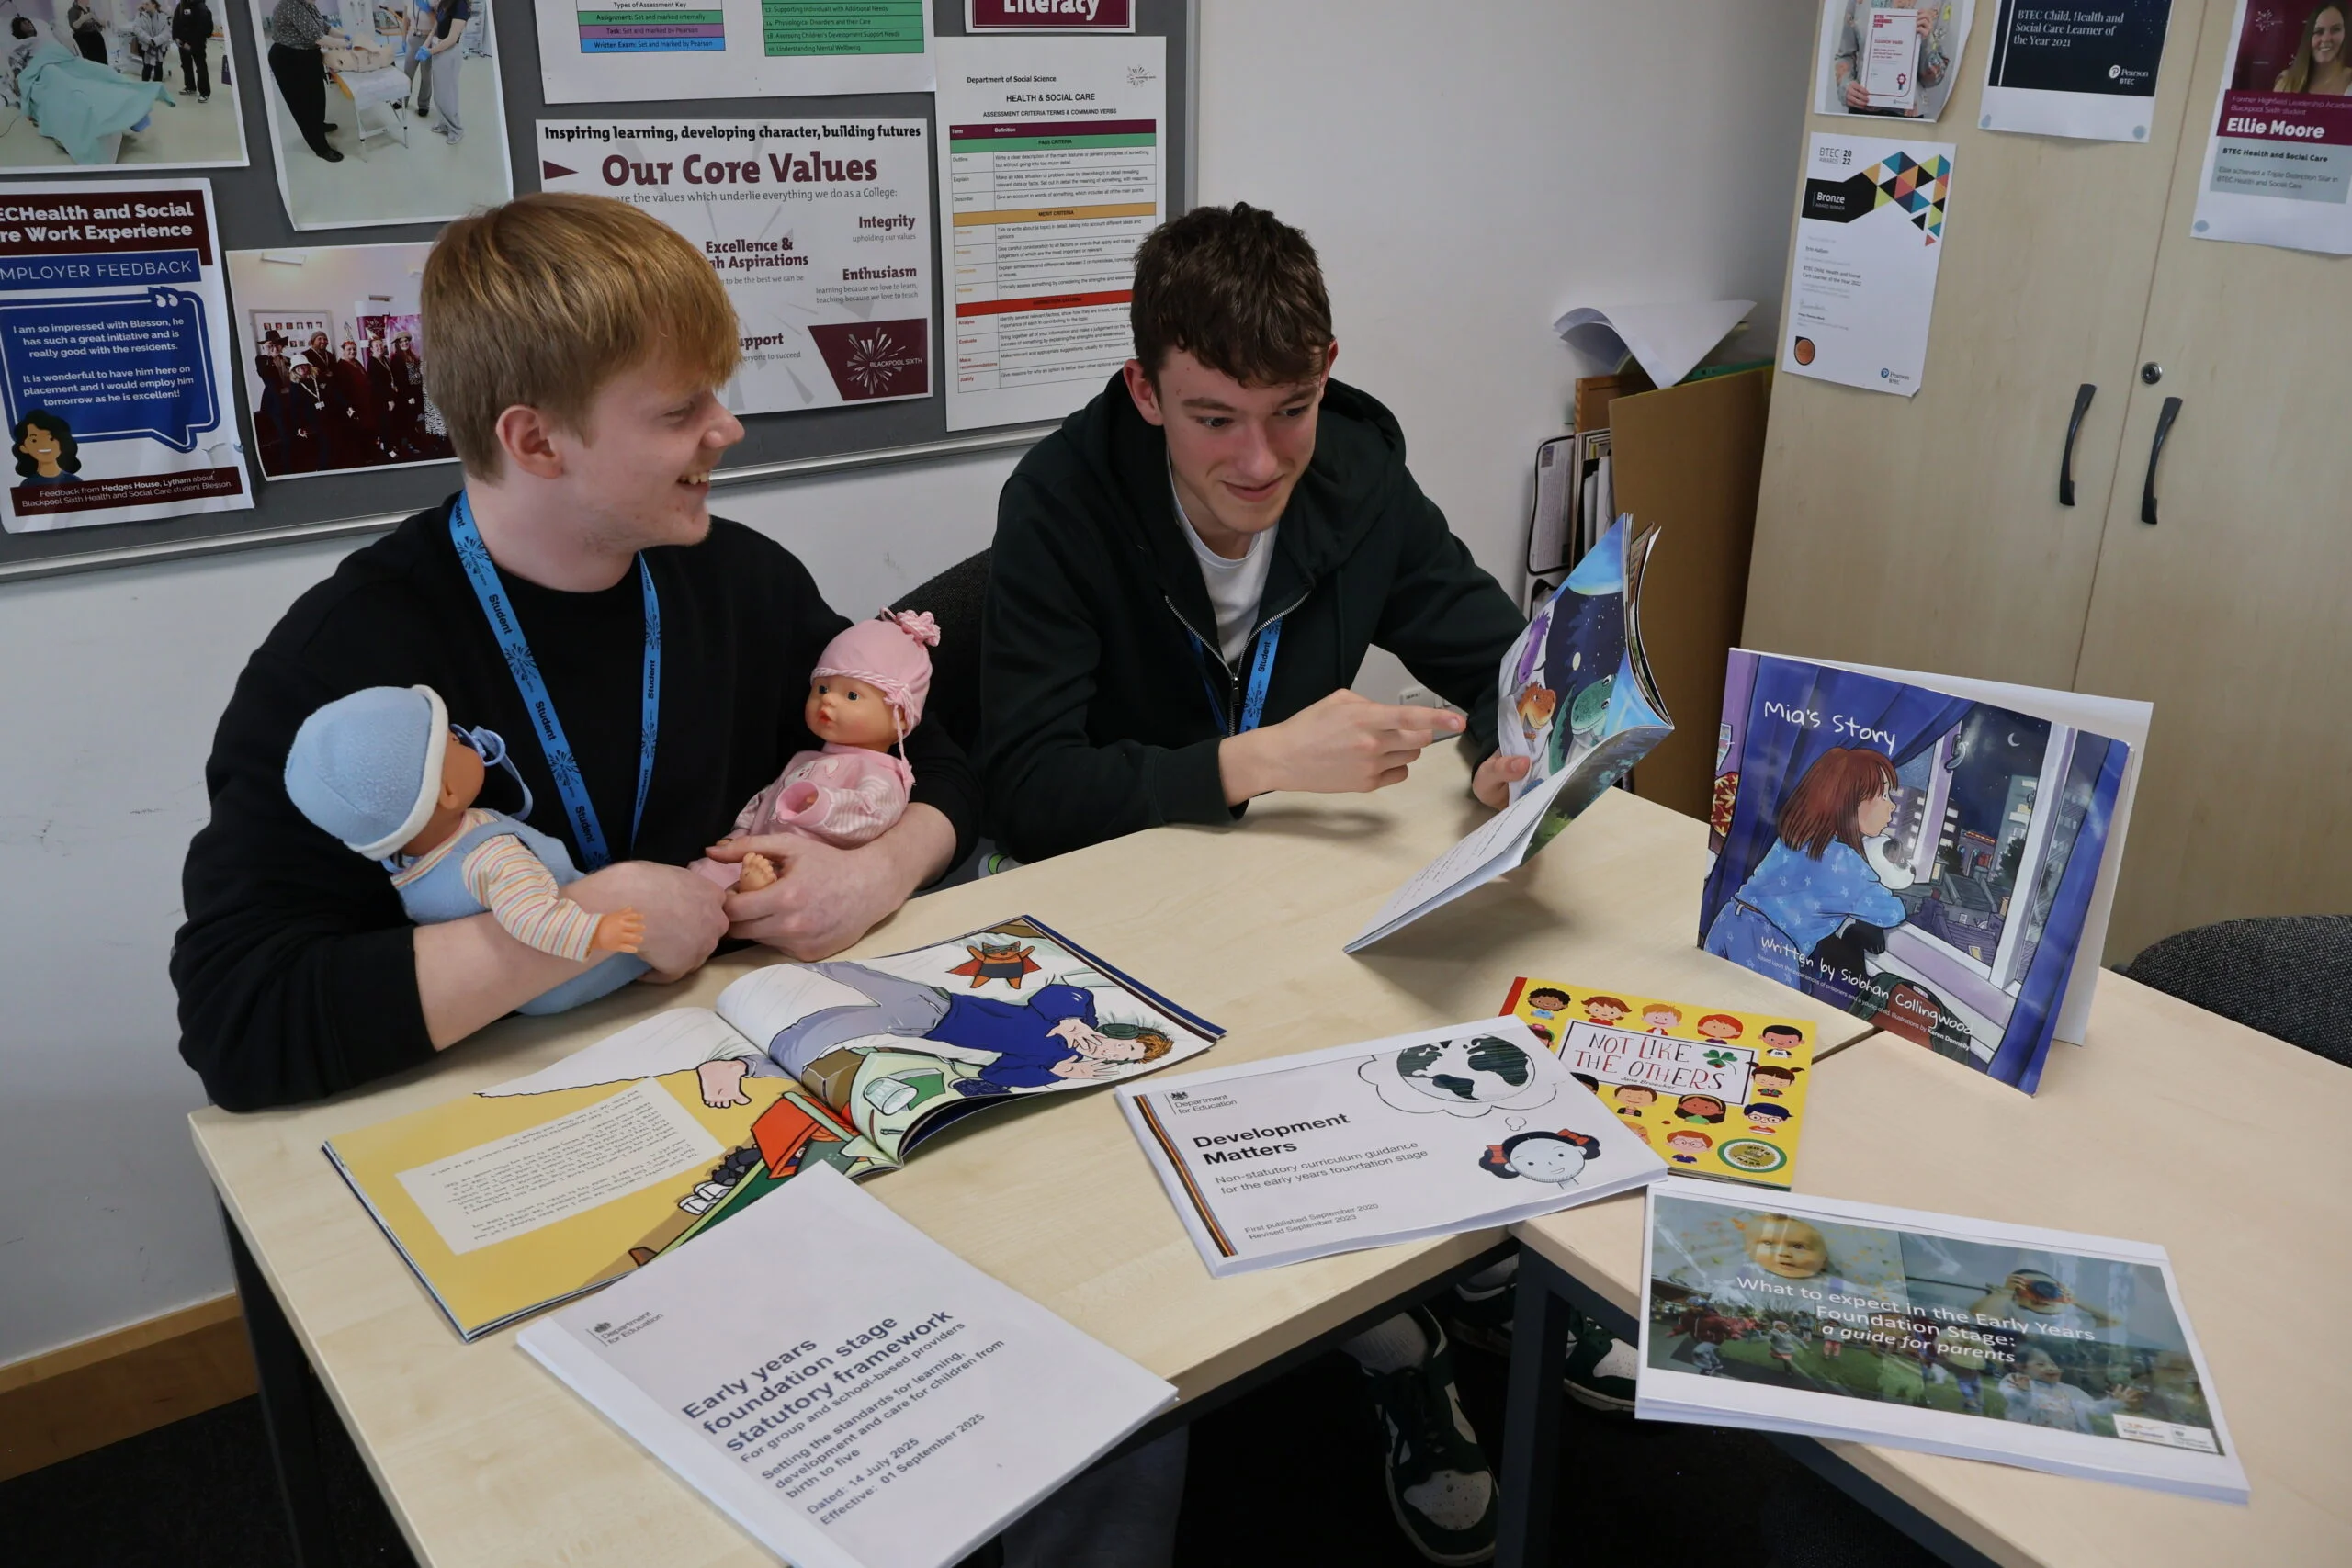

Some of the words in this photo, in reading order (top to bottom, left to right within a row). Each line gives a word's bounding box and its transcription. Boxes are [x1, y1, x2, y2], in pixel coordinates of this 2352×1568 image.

[1003, 0, 1101, 21] Literacy
[2018, 9, 2041, 19] BTEC
[2073, 11, 2104, 22] Health
[2105, 12, 2124, 23] and
[2013, 35, 2028, 44] the
[2030, 36, 2050, 45] Year
[2052, 39, 2071, 47] 2021
[2015, 22, 2041, 32] Social
[2042, 24, 2064, 33] Care
[2066, 24, 2103, 35] Learner
[2104, 25, 2116, 36] of
[1006, 94, 1036, 102] HEALTH
[1038, 94, 1044, 102] &
[1045, 93, 1072, 101] SOCIAL
[1074, 93, 1095, 101] CARE
[545, 125, 610, 142] Inspiring
[613, 125, 678, 141] learning,
[681, 125, 755, 141] developing
[758, 125, 820, 139] character,
[822, 124, 875, 140] building
[877, 124, 920, 137] futures
[2226, 117, 2266, 133] Ellie
[2270, 120, 2324, 138] Moore
[1819, 147, 1840, 158] BTEC
[2243, 149, 2268, 157] Health
[602, 154, 672, 186] Our
[683, 154, 760, 184] Core
[769, 151, 876, 182] Values
[93, 203, 130, 219] and
[134, 202, 193, 218] Social
[1816, 191, 1845, 203] Bronze
[0, 231, 21, 242] re
[25, 225, 81, 241] Work
[85, 223, 191, 242] Experience
[859, 214, 915, 231] Integrity
[706, 239, 777, 253] Excellence
[781, 236, 793, 251] &
[0, 265, 90, 279] MPLOYER
[97, 261, 190, 276] FEEDBACK
[729, 254, 808, 271] Aspirations
[842, 265, 916, 280] Enthusiasm
[13, 325, 17, 333] I
[51, 321, 104, 333] impressed
[106, 321, 128, 329] with
[130, 320, 170, 328] Blesson,
[172, 317, 184, 325] he
[28, 348, 58, 358] really
[60, 346, 86, 357] good
[88, 345, 110, 354] with
[130, 343, 177, 352] residents.
[488, 593, 512, 636] Student
[1258, 642, 1272, 672] Student
[647, 660, 655, 700] Student
[534, 700, 558, 742] Student
[1764, 701, 1820, 728] Mia's
[1833, 715, 1896, 756] Story
[574, 805, 594, 845] Student
[1761, 937, 1813, 967] Written
[1820, 958, 1835, 981] by
[1841, 968, 1889, 998] Siobhan
[1895, 994, 1973, 1036] Collingwood
[1589, 1032, 1634, 1055] NOT
[1639, 1036, 1692, 1063] LIKE
[1575, 1049, 1622, 1074] THE
[1628, 1060, 1725, 1090] OTHERS
[1174, 1094, 1228, 1109] Department
[1192, 1100, 1237, 1111] Education
[1193, 1114, 1348, 1147] Development
[1203, 1143, 1296, 1164] Matters
[1215, 1165, 1296, 1183] Non-statutory
[1300, 1154, 1362, 1168] curriculum
[1364, 1143, 1418, 1158] guidance
[1220, 1186, 1237, 1194] for
[1240, 1182, 1261, 1190] the
[1263, 1176, 1292, 1186] early
[1295, 1170, 1328, 1181] years
[1329, 1157, 1393, 1173] foundation
[1395, 1150, 1428, 1161] stage
[1244, 1224, 1264, 1235] First
[1265, 1216, 1307, 1229] published
[1308, 1208, 1354, 1222] September
[1249, 1228, 1284, 1239] Revised
[1285, 1219, 1332, 1232] September
[1736, 1277, 1793, 1295] What
[1801, 1287, 1822, 1300] to
[1828, 1293, 1898, 1314] expect
[1906, 1303, 1926, 1316] in
[1932, 1307, 1968, 1323] the
[1975, 1313, 2029, 1333] Early
[2035, 1321, 2094, 1340] Years
[601, 1311, 652, 1339] Department
[606, 1336, 620, 1344] for
[620, 1314, 662, 1337] Education
[1816, 1305, 1940, 1336] Foundation
[1948, 1326, 2015, 1347] Stage:
[1822, 1325, 1834, 1335] a
[1839, 1328, 1895, 1344] guide
[1900, 1335, 1928, 1349] for
[1937, 1343, 2014, 1362] parents
[683, 1379, 748, 1418] Early
[752, 1340, 816, 1382] years
[703, 1357, 832, 1433] foundation
[836, 1318, 897, 1357] stage
[727, 1382, 832, 1450] statutory
[834, 1312, 951, 1382] framework
[740, 1447, 764, 1462] For
[767, 1422, 805, 1449] group
[807, 1404, 831, 1422] and
[831, 1356, 910, 1405] school-based
[911, 1323, 965, 1359] providers
[762, 1449, 811, 1479] Setting
[809, 1434, 831, 1449] the
[833, 1395, 893, 1434] standards
[893, 1382, 911, 1395] for
[912, 1352, 964, 1383] learning,
[775, 1434, 857, 1488] development
[858, 1416, 882, 1435] and
[883, 1400, 910, 1418] care
[909, 1388, 928, 1401] for
[930, 1359, 976, 1389] children
[975, 1340, 1004, 1359] from
[786, 1476, 819, 1498] birth
[819, 1466, 834, 1476] to
[834, 1450, 860, 1466] five
[807, 1488, 844, 1514] Dated:
[848, 1474, 865, 1485] 14
[866, 1458, 890, 1476] July
[889, 1438, 919, 1459] 2025
[820, 1488, 873, 1524] Effective:
[880, 1472, 896, 1483] 01
[896, 1431, 956, 1472] September
[956, 1413, 984, 1432] 2025
